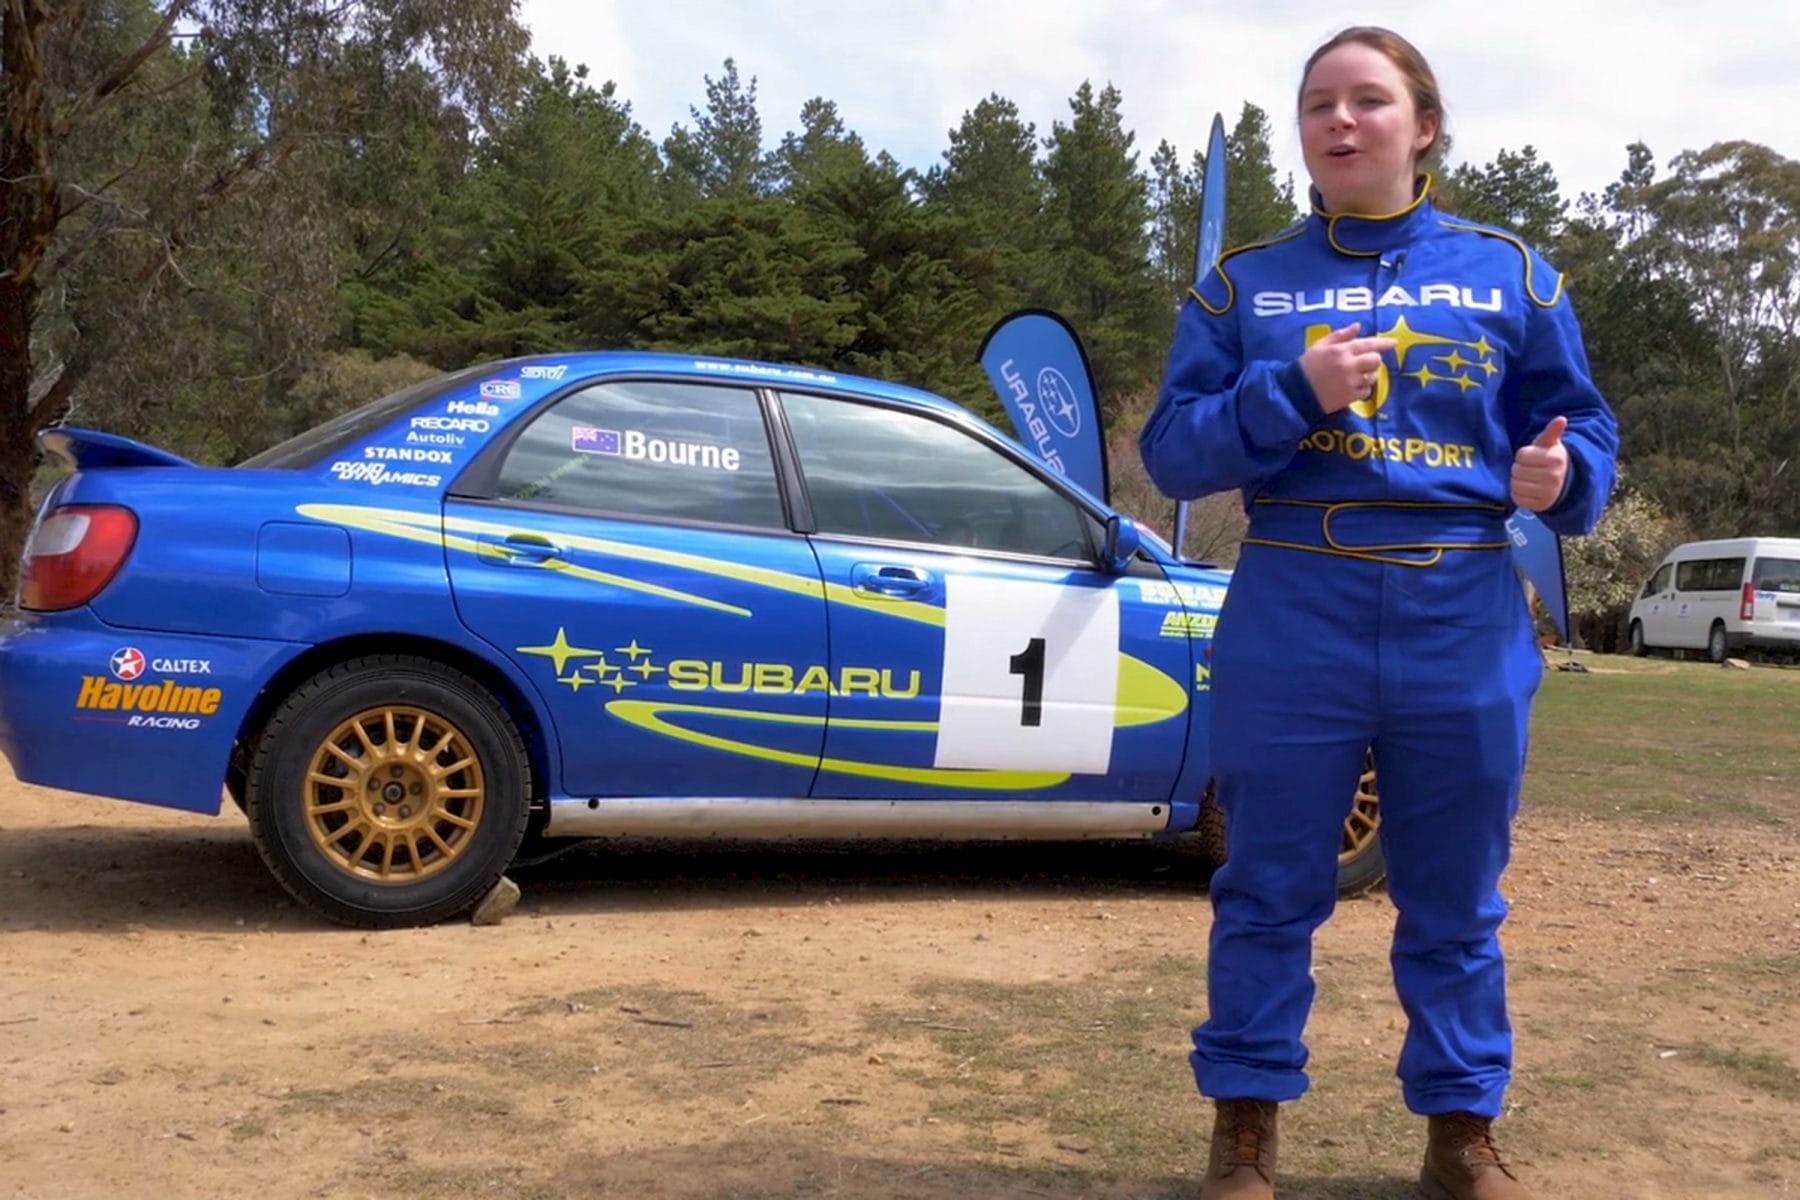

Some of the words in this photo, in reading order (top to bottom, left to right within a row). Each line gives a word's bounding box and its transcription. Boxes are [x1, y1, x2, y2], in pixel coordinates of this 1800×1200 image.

[1253, 284, 1502, 316] SUBARU
[447, 401, 499, 417] Hella
[411, 416, 489, 433] RECARO
[406, 431, 465, 446] Autoliv
[364, 446, 453, 464] STANDOX
[625, 430, 740, 470] Bourne
[338, 470, 441, 486] DYNAMICS
[152, 658, 211, 674] CALTEX
[668, 659, 921, 698] SUBARU
[1009, 638, 1046, 726] 1
[76, 676, 222, 714] Havoline
[128, 715, 201, 730] RACING
